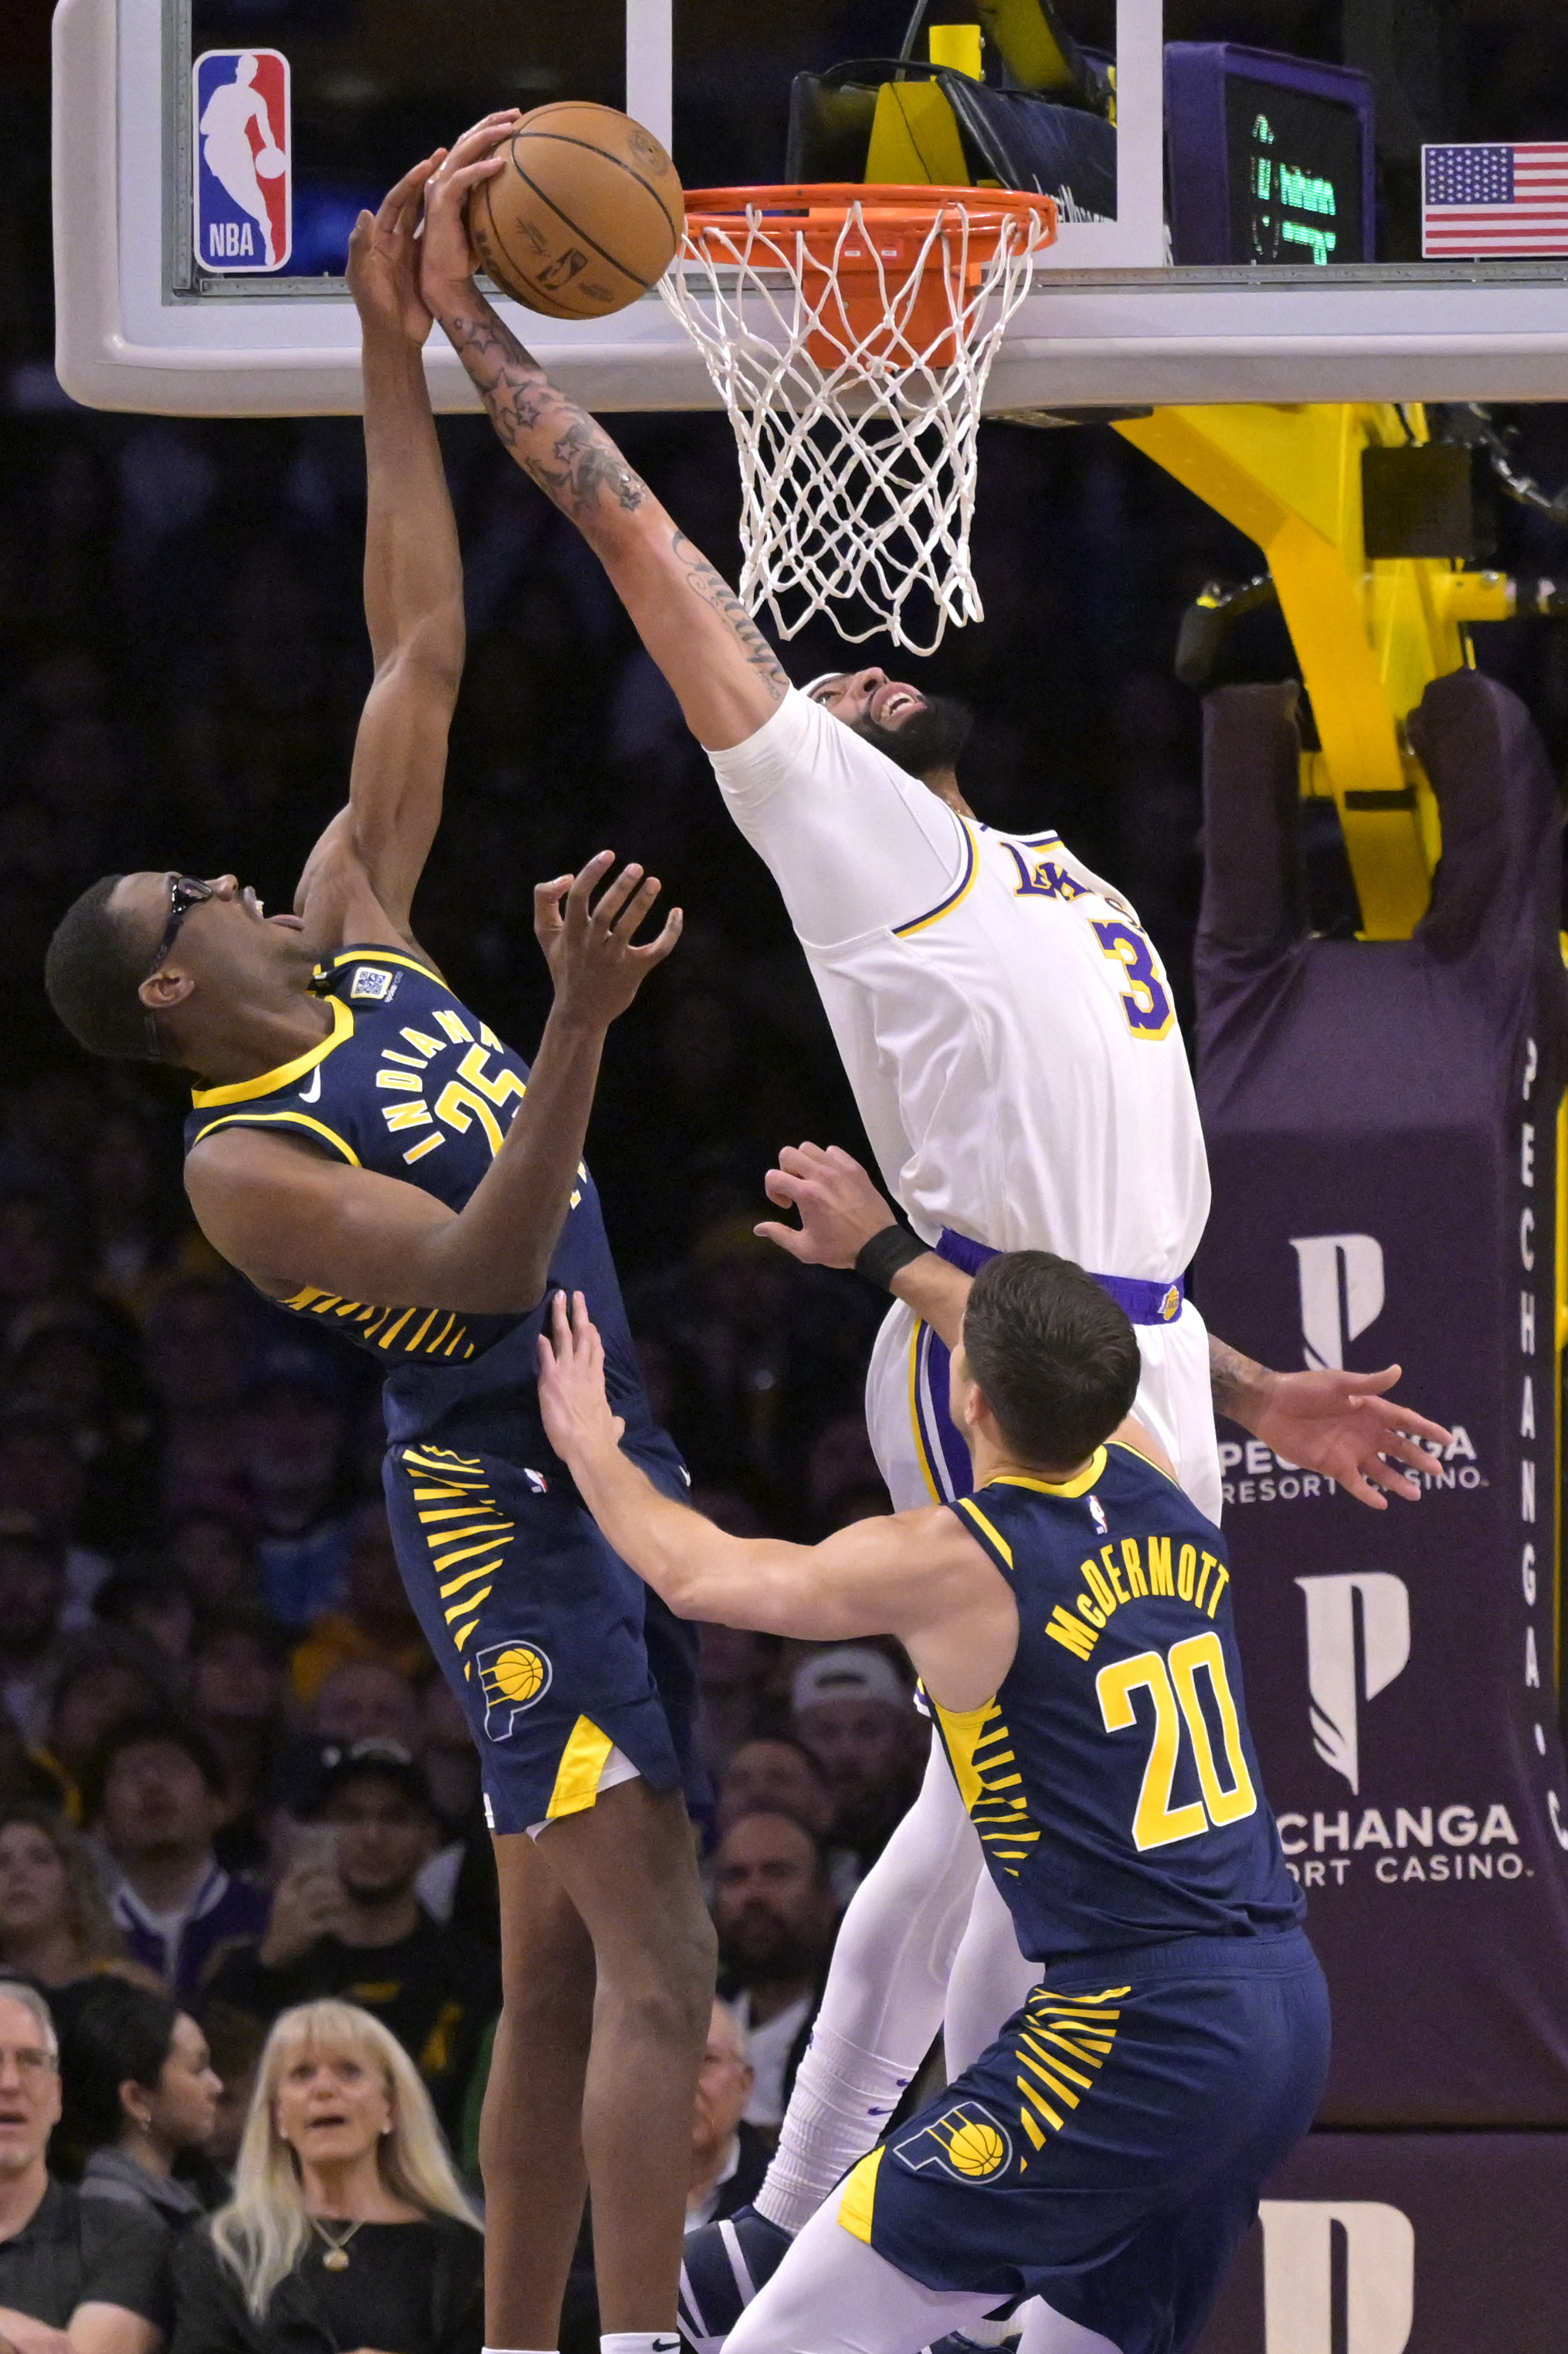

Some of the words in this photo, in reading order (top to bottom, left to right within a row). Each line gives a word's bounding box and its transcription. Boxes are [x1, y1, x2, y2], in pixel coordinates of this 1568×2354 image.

[209, 222, 254, 256] NBA
[1088, 918, 1175, 1041] 3
[375, 1010, 504, 1165] INDIANA
[1044, 1536, 1230, 1662] McDERMOTT
[1095, 1631, 1257, 1852] 20
[1275, 1803, 1519, 1855] CHANGA
[1375, 1853, 1523, 1884] CASINO
